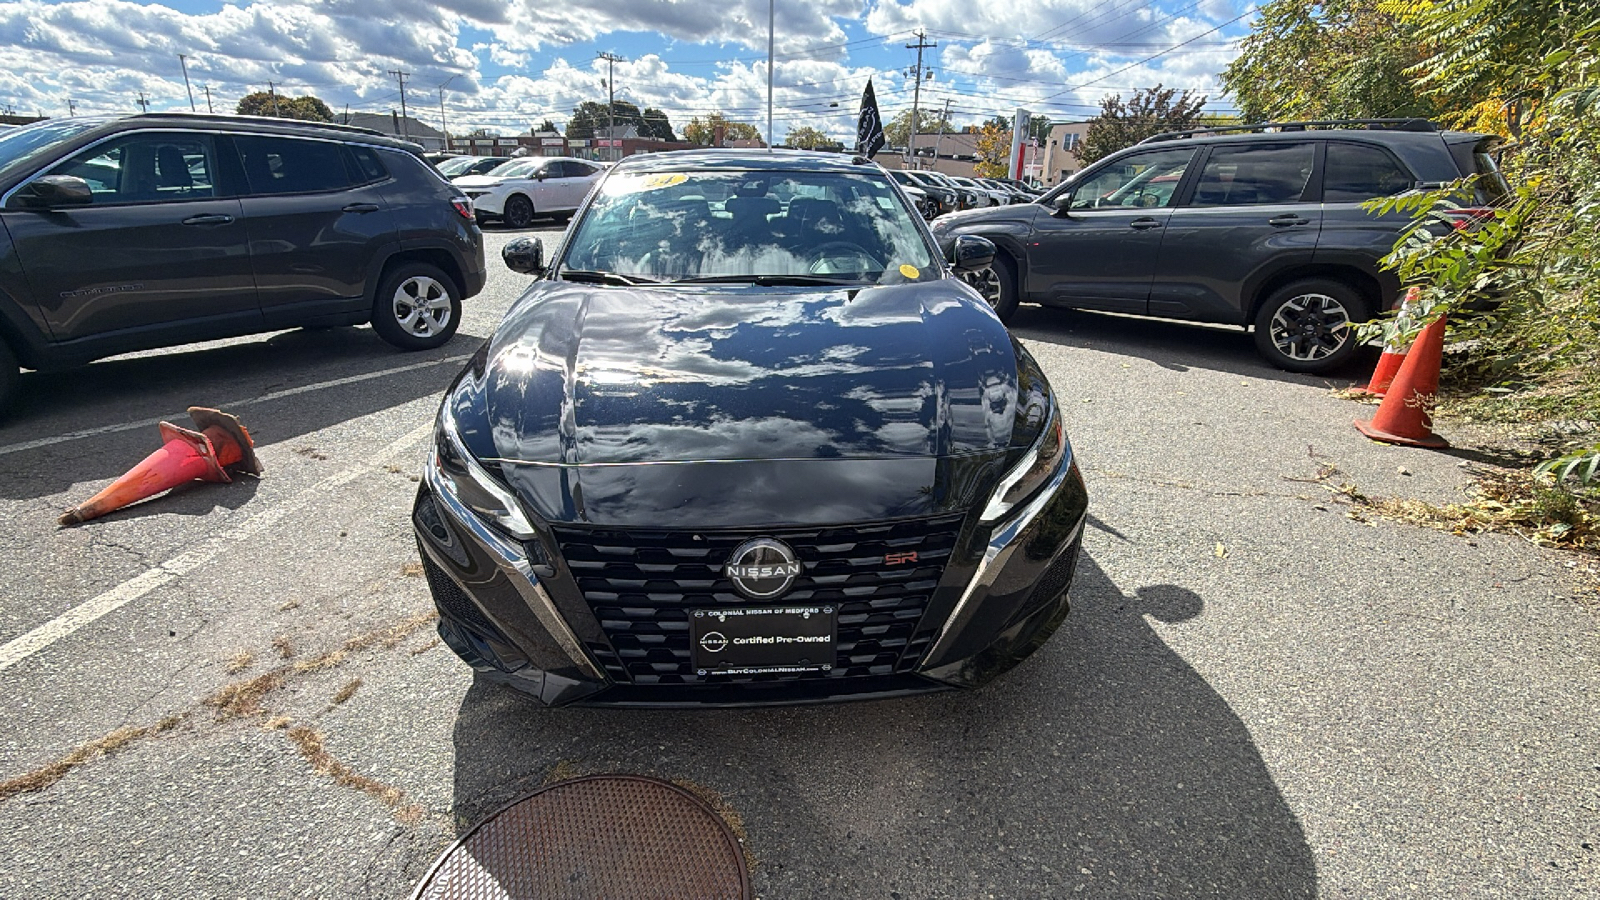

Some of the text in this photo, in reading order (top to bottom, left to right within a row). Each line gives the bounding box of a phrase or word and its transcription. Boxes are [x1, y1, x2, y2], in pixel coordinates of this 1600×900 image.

[885, 551, 918, 565] SR
[727, 564, 799, 576] NISSAN
[708, 609, 744, 617] COLONIAL
[733, 635, 831, 645] Certified Pre-Owned
